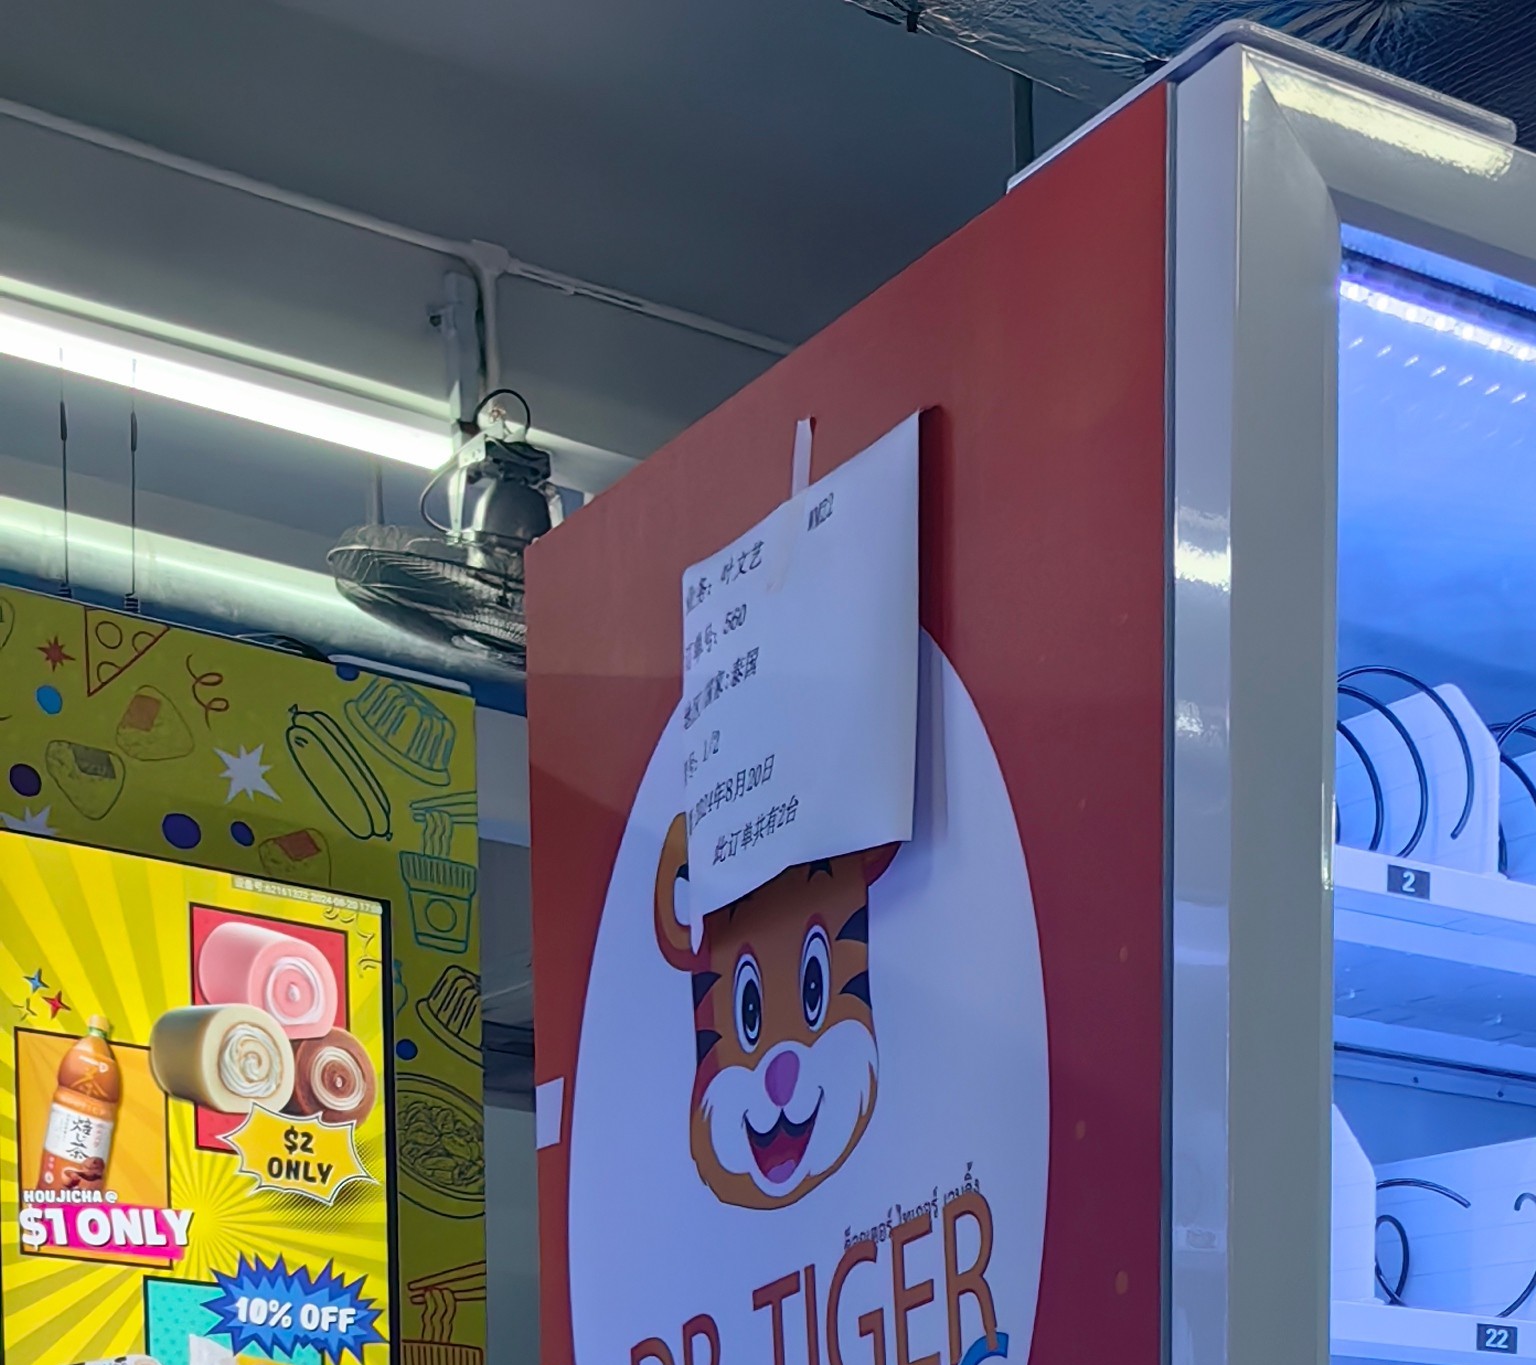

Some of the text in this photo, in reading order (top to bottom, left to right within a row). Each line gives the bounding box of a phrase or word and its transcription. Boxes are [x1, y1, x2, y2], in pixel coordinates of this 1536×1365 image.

[1402, 870, 1416, 893] 2
[283, 1125, 315, 1155] $2
[267, 1157, 334, 1185] ONLY
[23, 1190, 103, 1204] HOUJICHA
[19, 1207, 194, 1250] $1 ONLY
[236, 1296, 357, 1332] 10% OFF
[1485, 1328, 1509, 1349] 22
